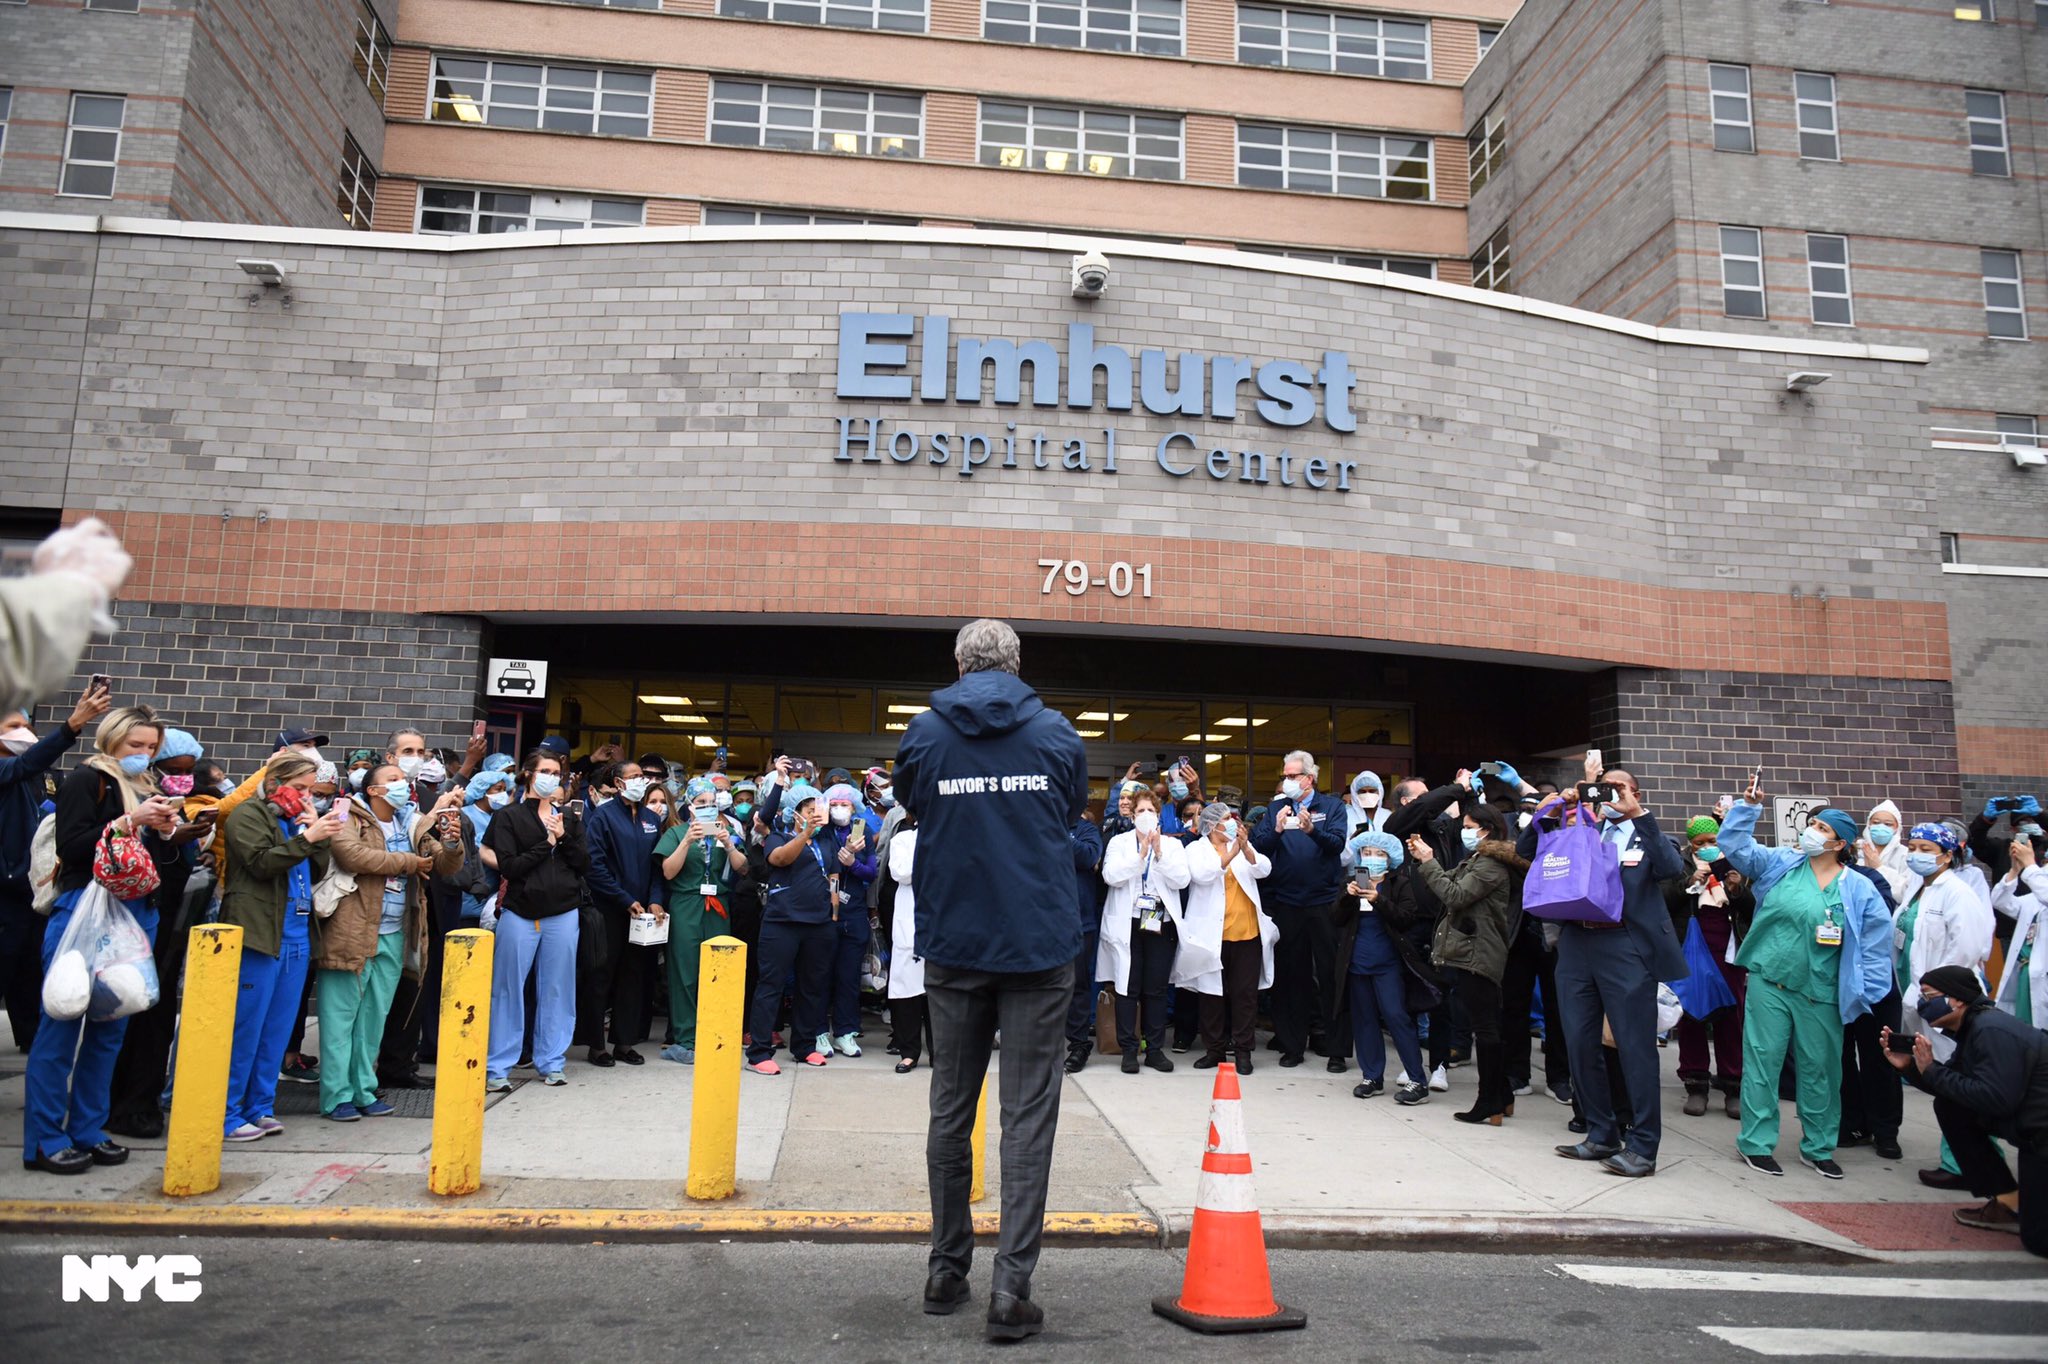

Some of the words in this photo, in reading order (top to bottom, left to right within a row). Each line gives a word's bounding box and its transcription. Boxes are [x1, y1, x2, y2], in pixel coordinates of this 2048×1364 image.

[836, 312, 1358, 433] Elmhurst
[834, 416, 1118, 476] Hospital
[1156, 432, 1358, 491] Center
[1038, 558, 1153, 598] 79-01
[510, 661, 527, 669] TAXI
[938, 776, 999, 795] MAYOR'S
[1001, 775, 1049, 792] OFFICE
